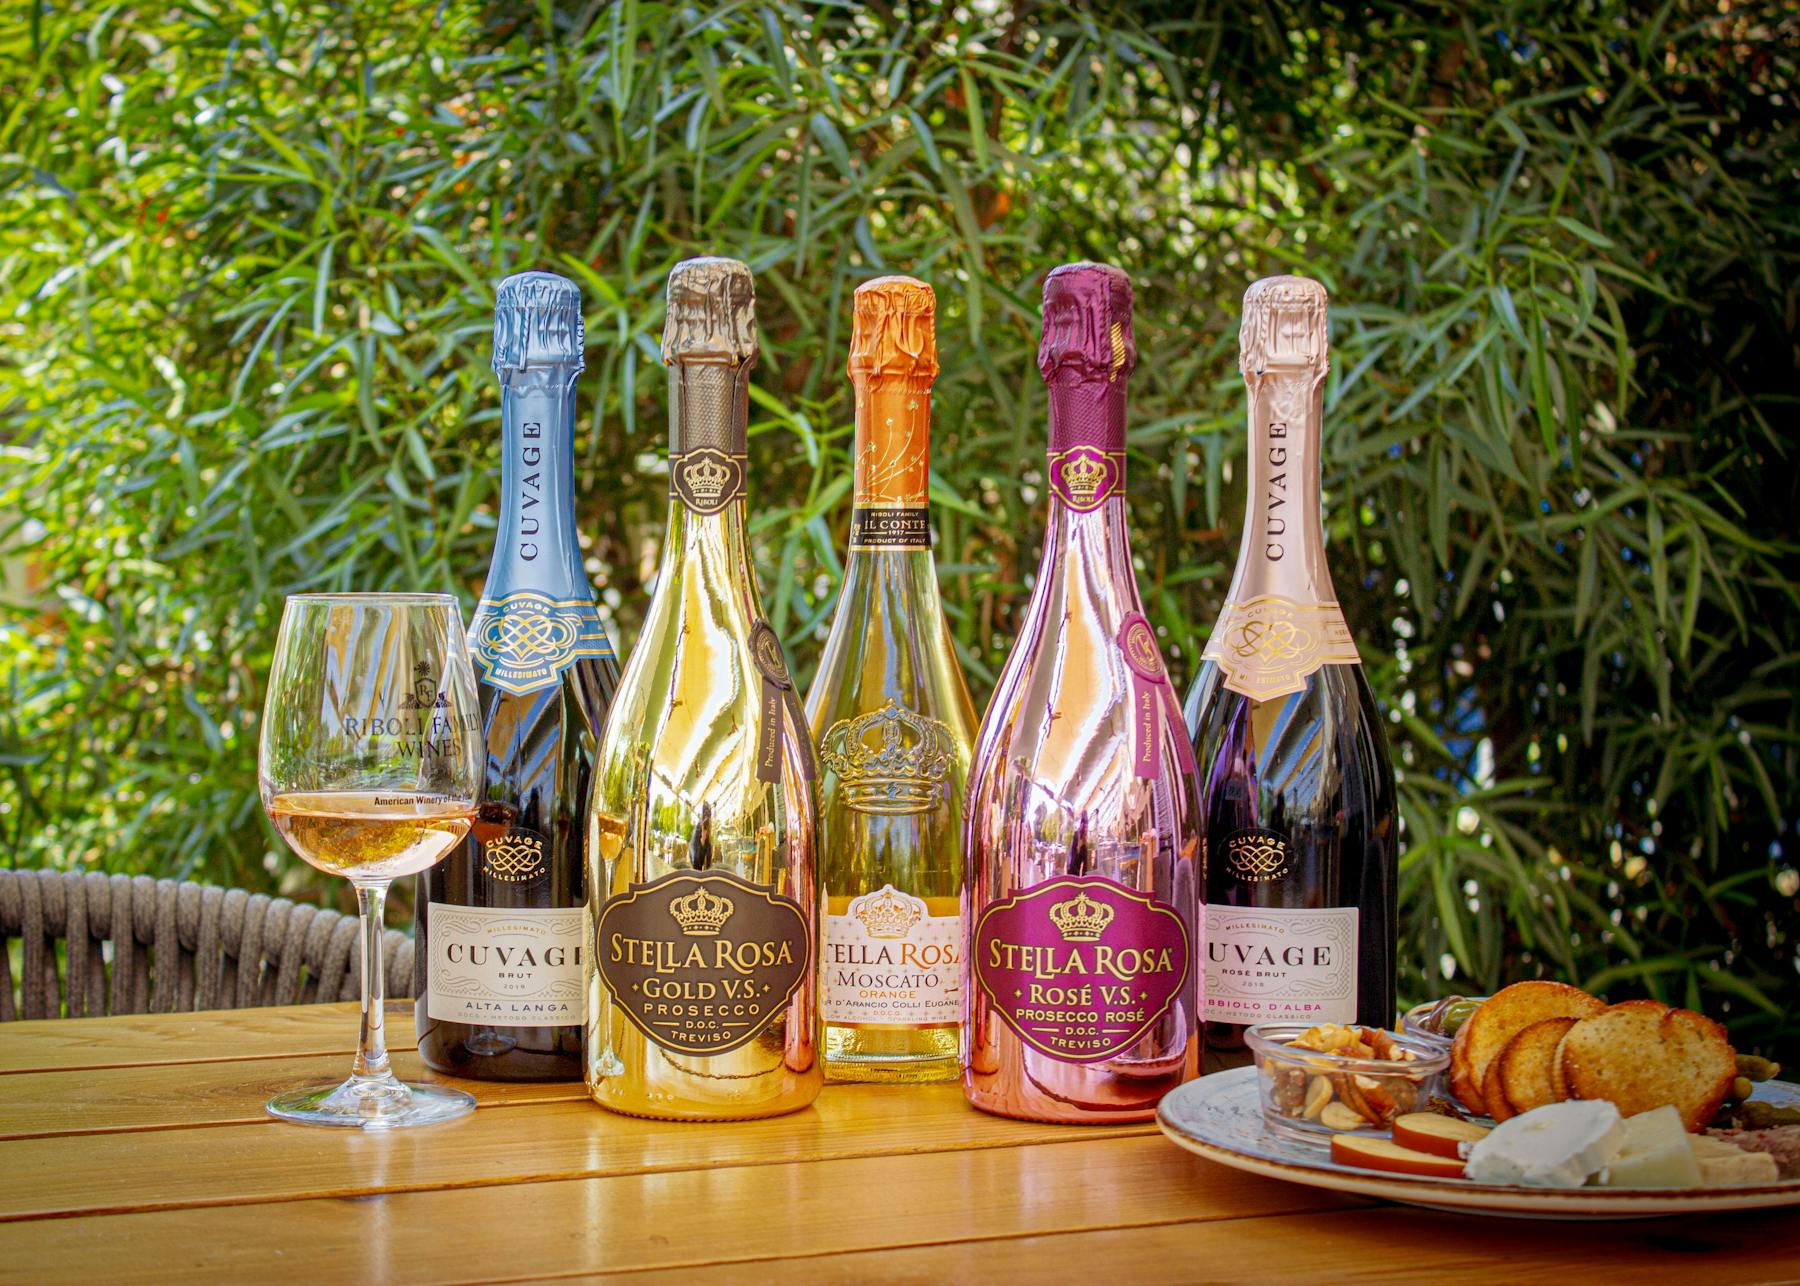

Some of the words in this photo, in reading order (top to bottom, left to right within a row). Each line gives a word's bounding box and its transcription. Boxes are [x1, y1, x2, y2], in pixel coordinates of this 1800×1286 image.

[520, 422, 541, 561] CUVAGE
[1265, 422, 1287, 562] CUVAGE
[864, 520, 876, 530] IL
[880, 520, 926, 530] CONTE
[503, 601, 550, 614] CUVAGE
[345, 717, 423, 739] RIBOLI
[765, 728, 776, 767] Produced
[1142, 723, 1152, 763] Produced
[374, 796, 414, 806] American
[416, 795, 442, 806] Winery
[485, 836, 543, 850] CUVAGE
[1229, 836, 1286, 850] CUVAGE
[1226, 922, 1285, 934] MILLESIMATO
[611, 933, 708, 974] STELLA
[714, 940, 794, 975] ROSA
[826, 943, 894, 965] TELLA
[990, 938, 1088, 980] STELLA
[1093, 946, 1174, 981] ROSA
[1208, 942, 1331, 967] UVAGE
[1222, 968, 1251, 977] ROSÉ
[838, 971, 939, 989] MOSCATO
[643, 978, 716, 1000] GOLD
[721, 980, 760, 1000] V.S.
[859, 990, 917, 999] ORANGE
[1029, 983, 1092, 1006] ROSÉ
[1099, 986, 1136, 1006] V.S.
[465, 1001, 502, 1011] ALTA
[511, 1004, 569, 1012] LANGA
[644, 1003, 760, 1017] PROSECCO
[835, 999, 888, 1009] D'ARANCIO
[892, 1001, 921, 1009] COLLI
[925, 1000, 959, 1008] EUGANE
[1208, 999, 1261, 1010] BBIOLO
[1269, 1003, 1322, 1011] D'ALBA
[1016, 1009, 1099, 1022] PROSECCO
[1105, 1007, 1145, 1022] ROSÉ
[686, 1021, 719, 1029] D.O.C.
[1065, 1027, 1099, 1036] D.O.C.
[671, 1031, 731, 1042] TREVISO
[1050, 1037, 1111, 1049] TREVISO
